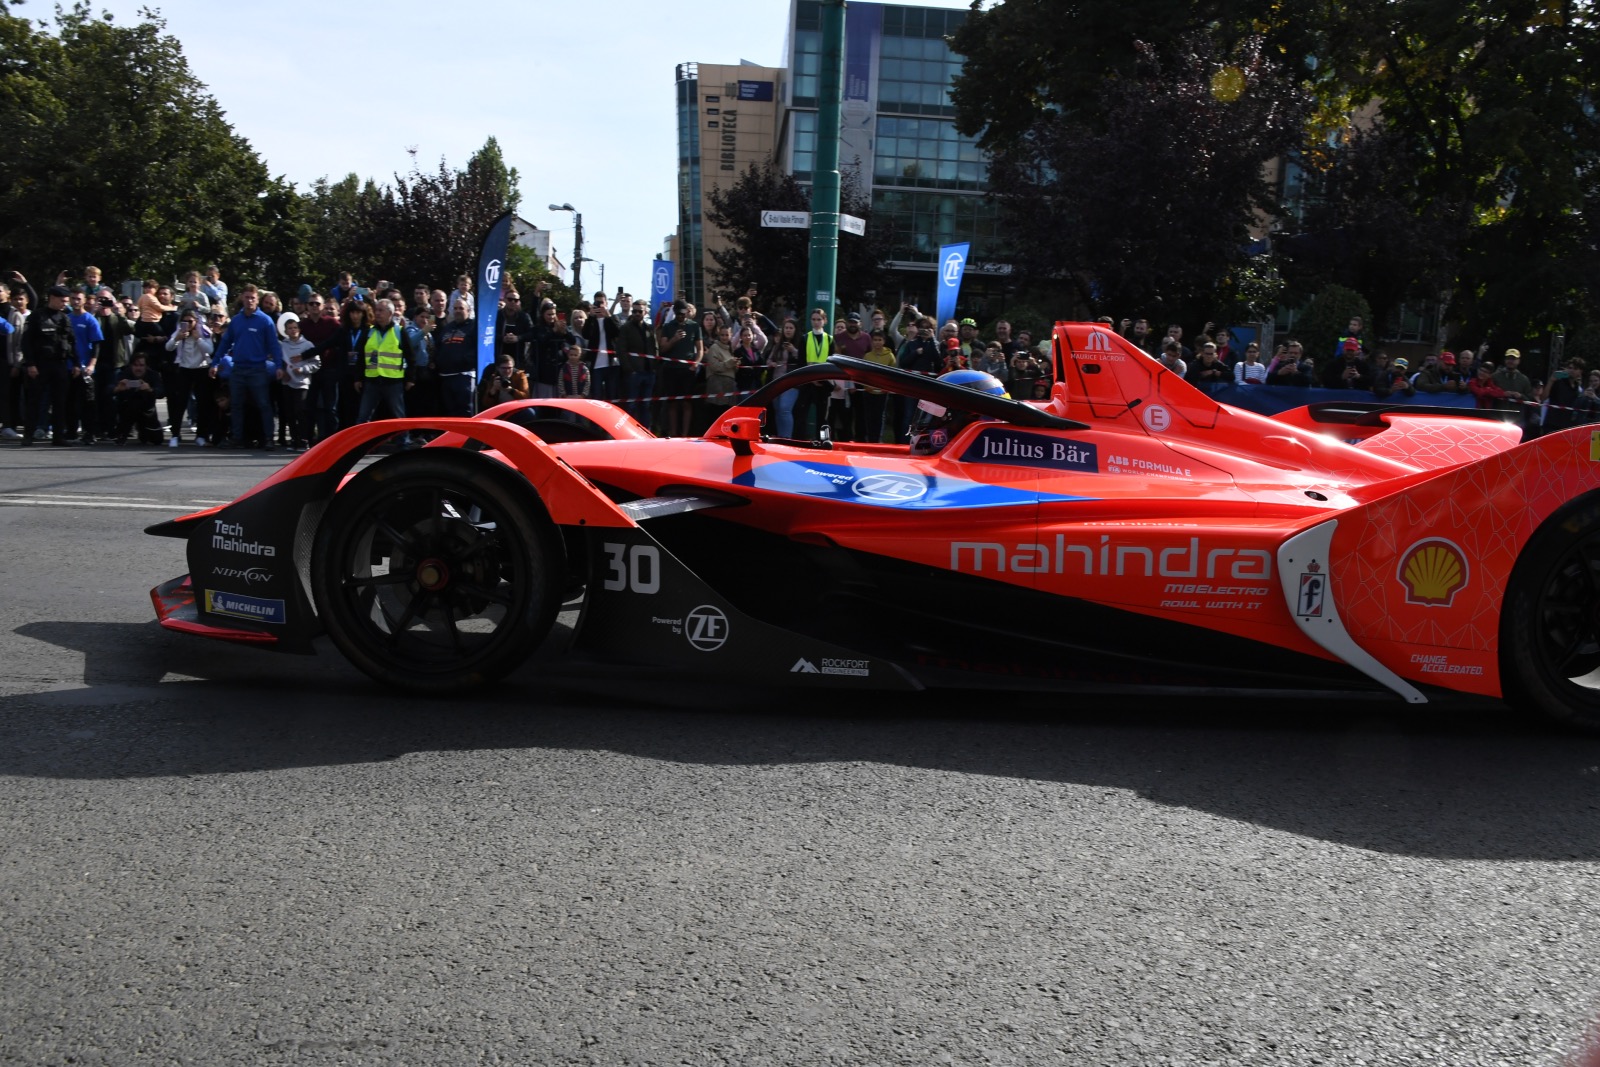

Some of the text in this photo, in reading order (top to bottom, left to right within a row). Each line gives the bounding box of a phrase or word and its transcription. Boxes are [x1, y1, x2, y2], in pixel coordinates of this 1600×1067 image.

[720, 109, 737, 171] BIBLIOTECA
[1070, 353, 1126, 362] MAURICE LACROIX
[1150, 408, 1164, 425] E
[982, 435, 1091, 464] Julius Bär
[1107, 454, 1192, 477] ABB FORMULA E
[1122, 468, 1145, 476] WORLD
[804, 467, 853, 481] Powered
[831, 477, 847, 486] by
[855, 475, 924, 499] ZF
[214, 519, 243, 536] Tech
[212, 535, 276, 557] Mahindra
[950, 533, 1272, 580] mahindra
[212, 566, 274, 586] NIPPON
[603, 542, 661, 595] 30
[225, 600, 276, 616] MICHELIN
[1205, 600, 1244, 610] WITH
[1246, 602, 1263, 610] IT
[651, 616, 682, 627] Powered
[687, 611, 729, 645] ZF
[671, 625, 682, 635] by
[821, 658, 870, 670] ROCKFORT
[1410, 653, 1448, 665] CHANGE.
[822, 668, 869, 676] ENGINEERING
[1420, 663, 1484, 675] ACCELERATED.
